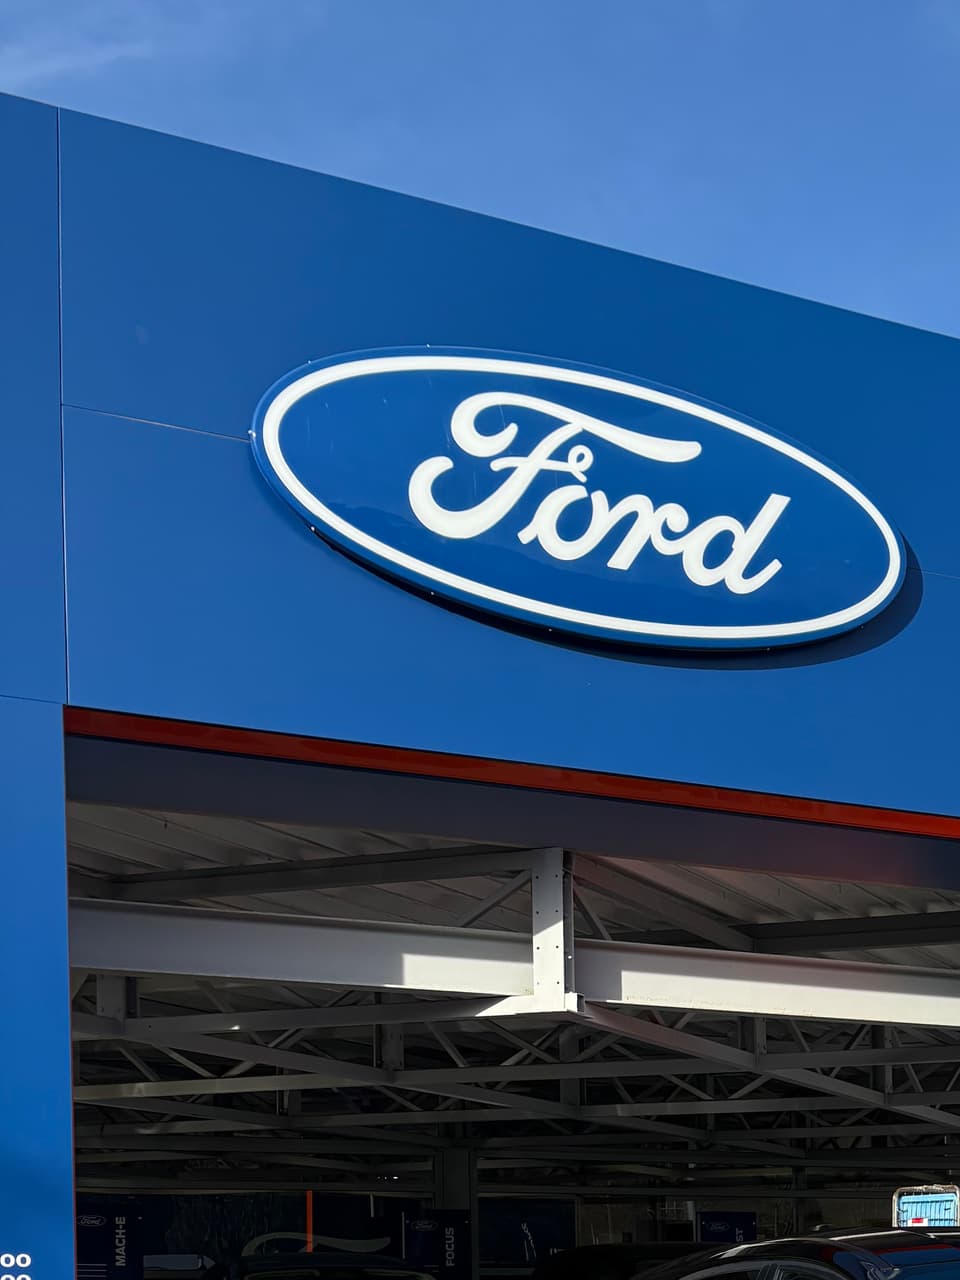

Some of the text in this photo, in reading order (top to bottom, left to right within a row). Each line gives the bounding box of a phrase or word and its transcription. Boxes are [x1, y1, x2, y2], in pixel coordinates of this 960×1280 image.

[408, 391, 791, 595] Ford
[115, 1216, 126, 1266] MACH-E
[445, 1227, 455, 1267] FOCUS
